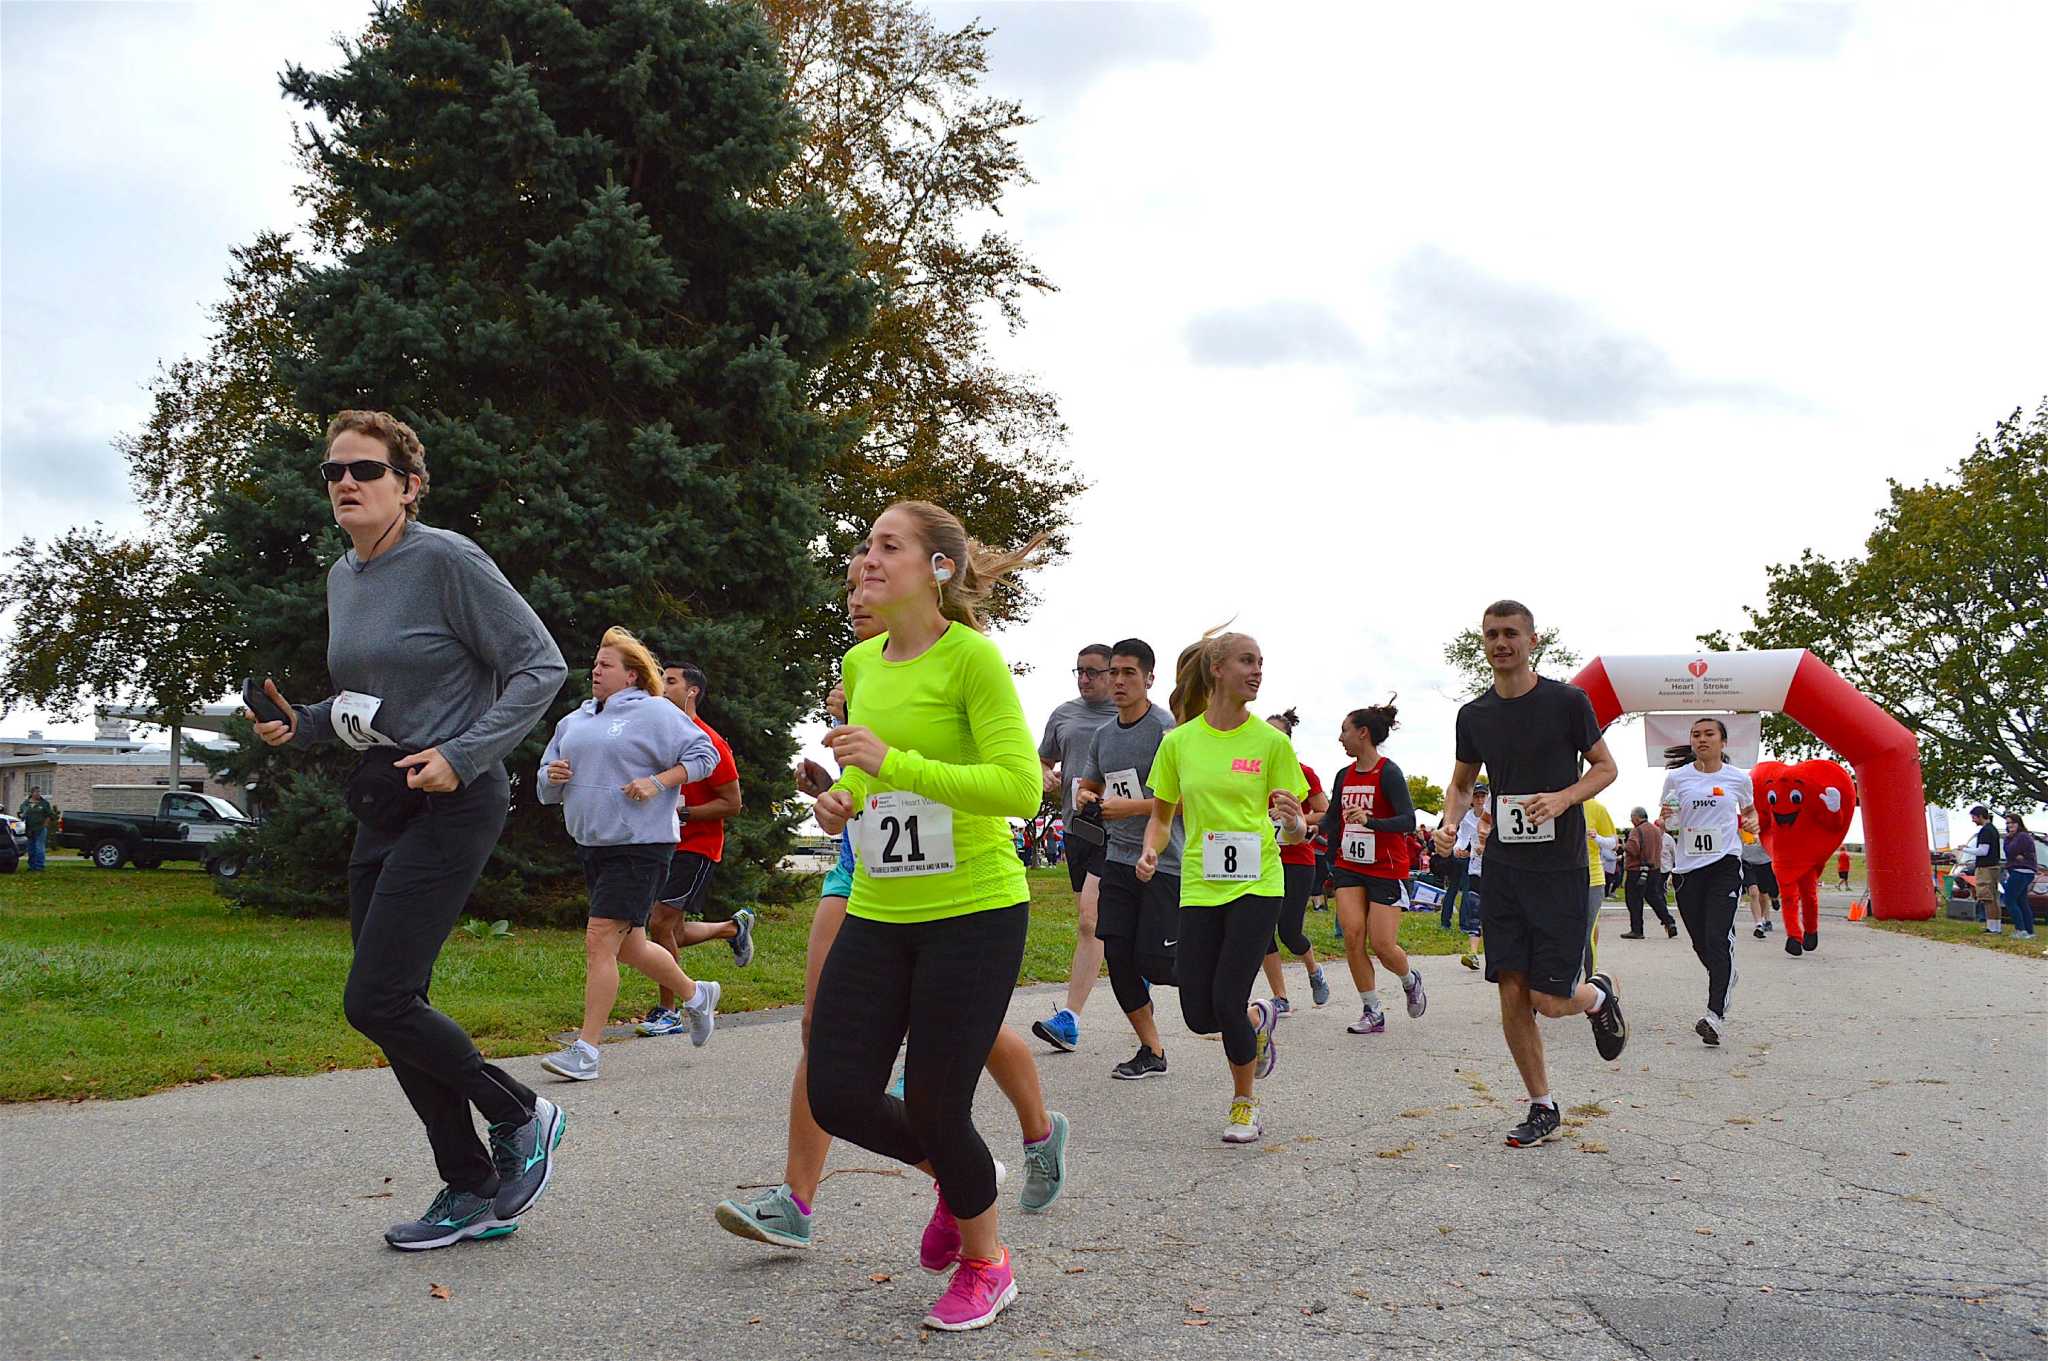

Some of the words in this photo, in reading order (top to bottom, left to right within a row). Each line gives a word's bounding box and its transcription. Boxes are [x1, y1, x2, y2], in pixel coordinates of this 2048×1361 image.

[341, 712, 380, 743] 20
[1341, 794, 1374, 809] RUN
[1692, 799, 1717, 809] pwc
[880, 815, 925, 863] 21
[1694, 834, 1713, 851] 40
[1349, 841, 1366, 858] 46
[1224, 845, 1237, 873] 8
